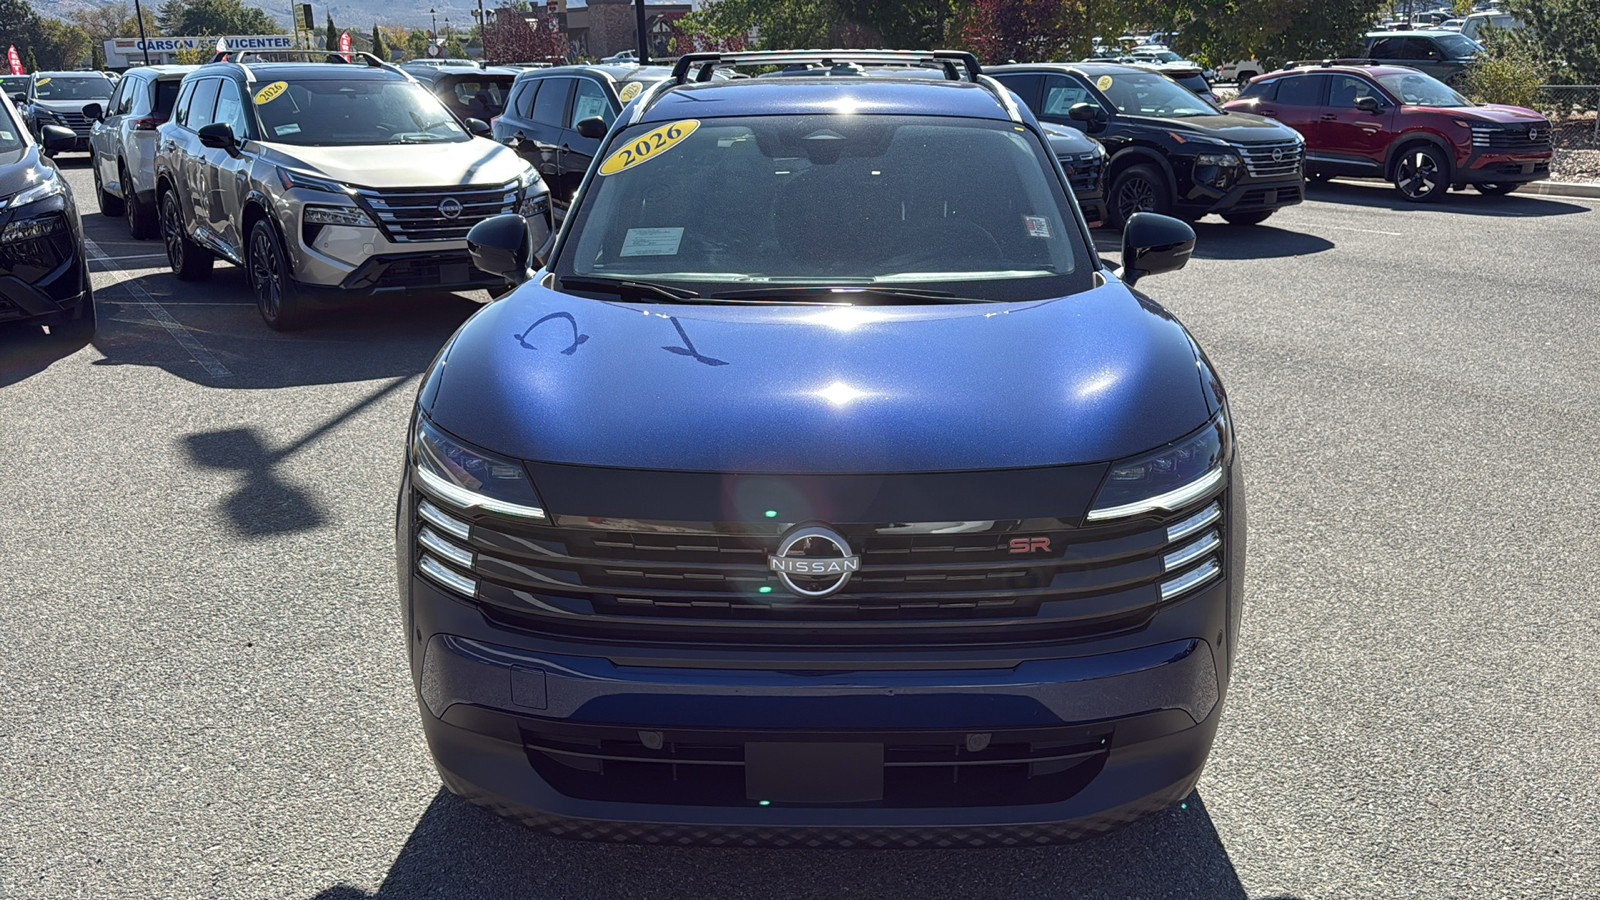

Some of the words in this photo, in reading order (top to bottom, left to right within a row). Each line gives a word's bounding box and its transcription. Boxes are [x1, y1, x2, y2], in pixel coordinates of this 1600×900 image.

[136, 39, 193, 50] CARSON
[200, 37, 291, 49] SEVICENTER
[259, 83, 283, 101] 2026
[618, 123, 682, 167] 2026
[1010, 537, 1052, 552] SR
[772, 558, 857, 572] NISSAN
